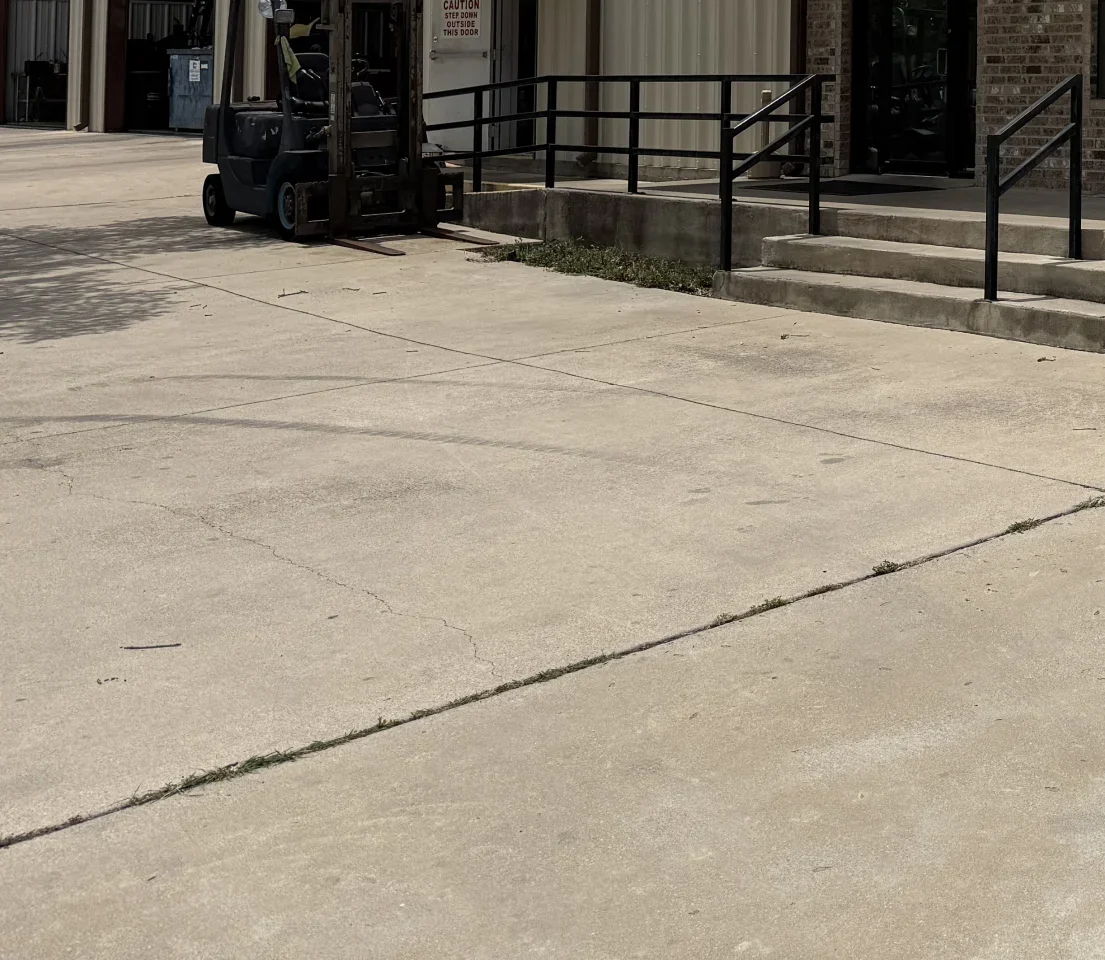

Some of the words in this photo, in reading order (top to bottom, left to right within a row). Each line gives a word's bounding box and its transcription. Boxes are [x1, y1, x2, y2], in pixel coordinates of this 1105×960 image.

[443, 0, 480, 10] CAUTION
[460, 11, 478, 19] DOWN
[446, 20, 476, 28] OUTSIDE
[460, 28, 479, 36] DOOR
